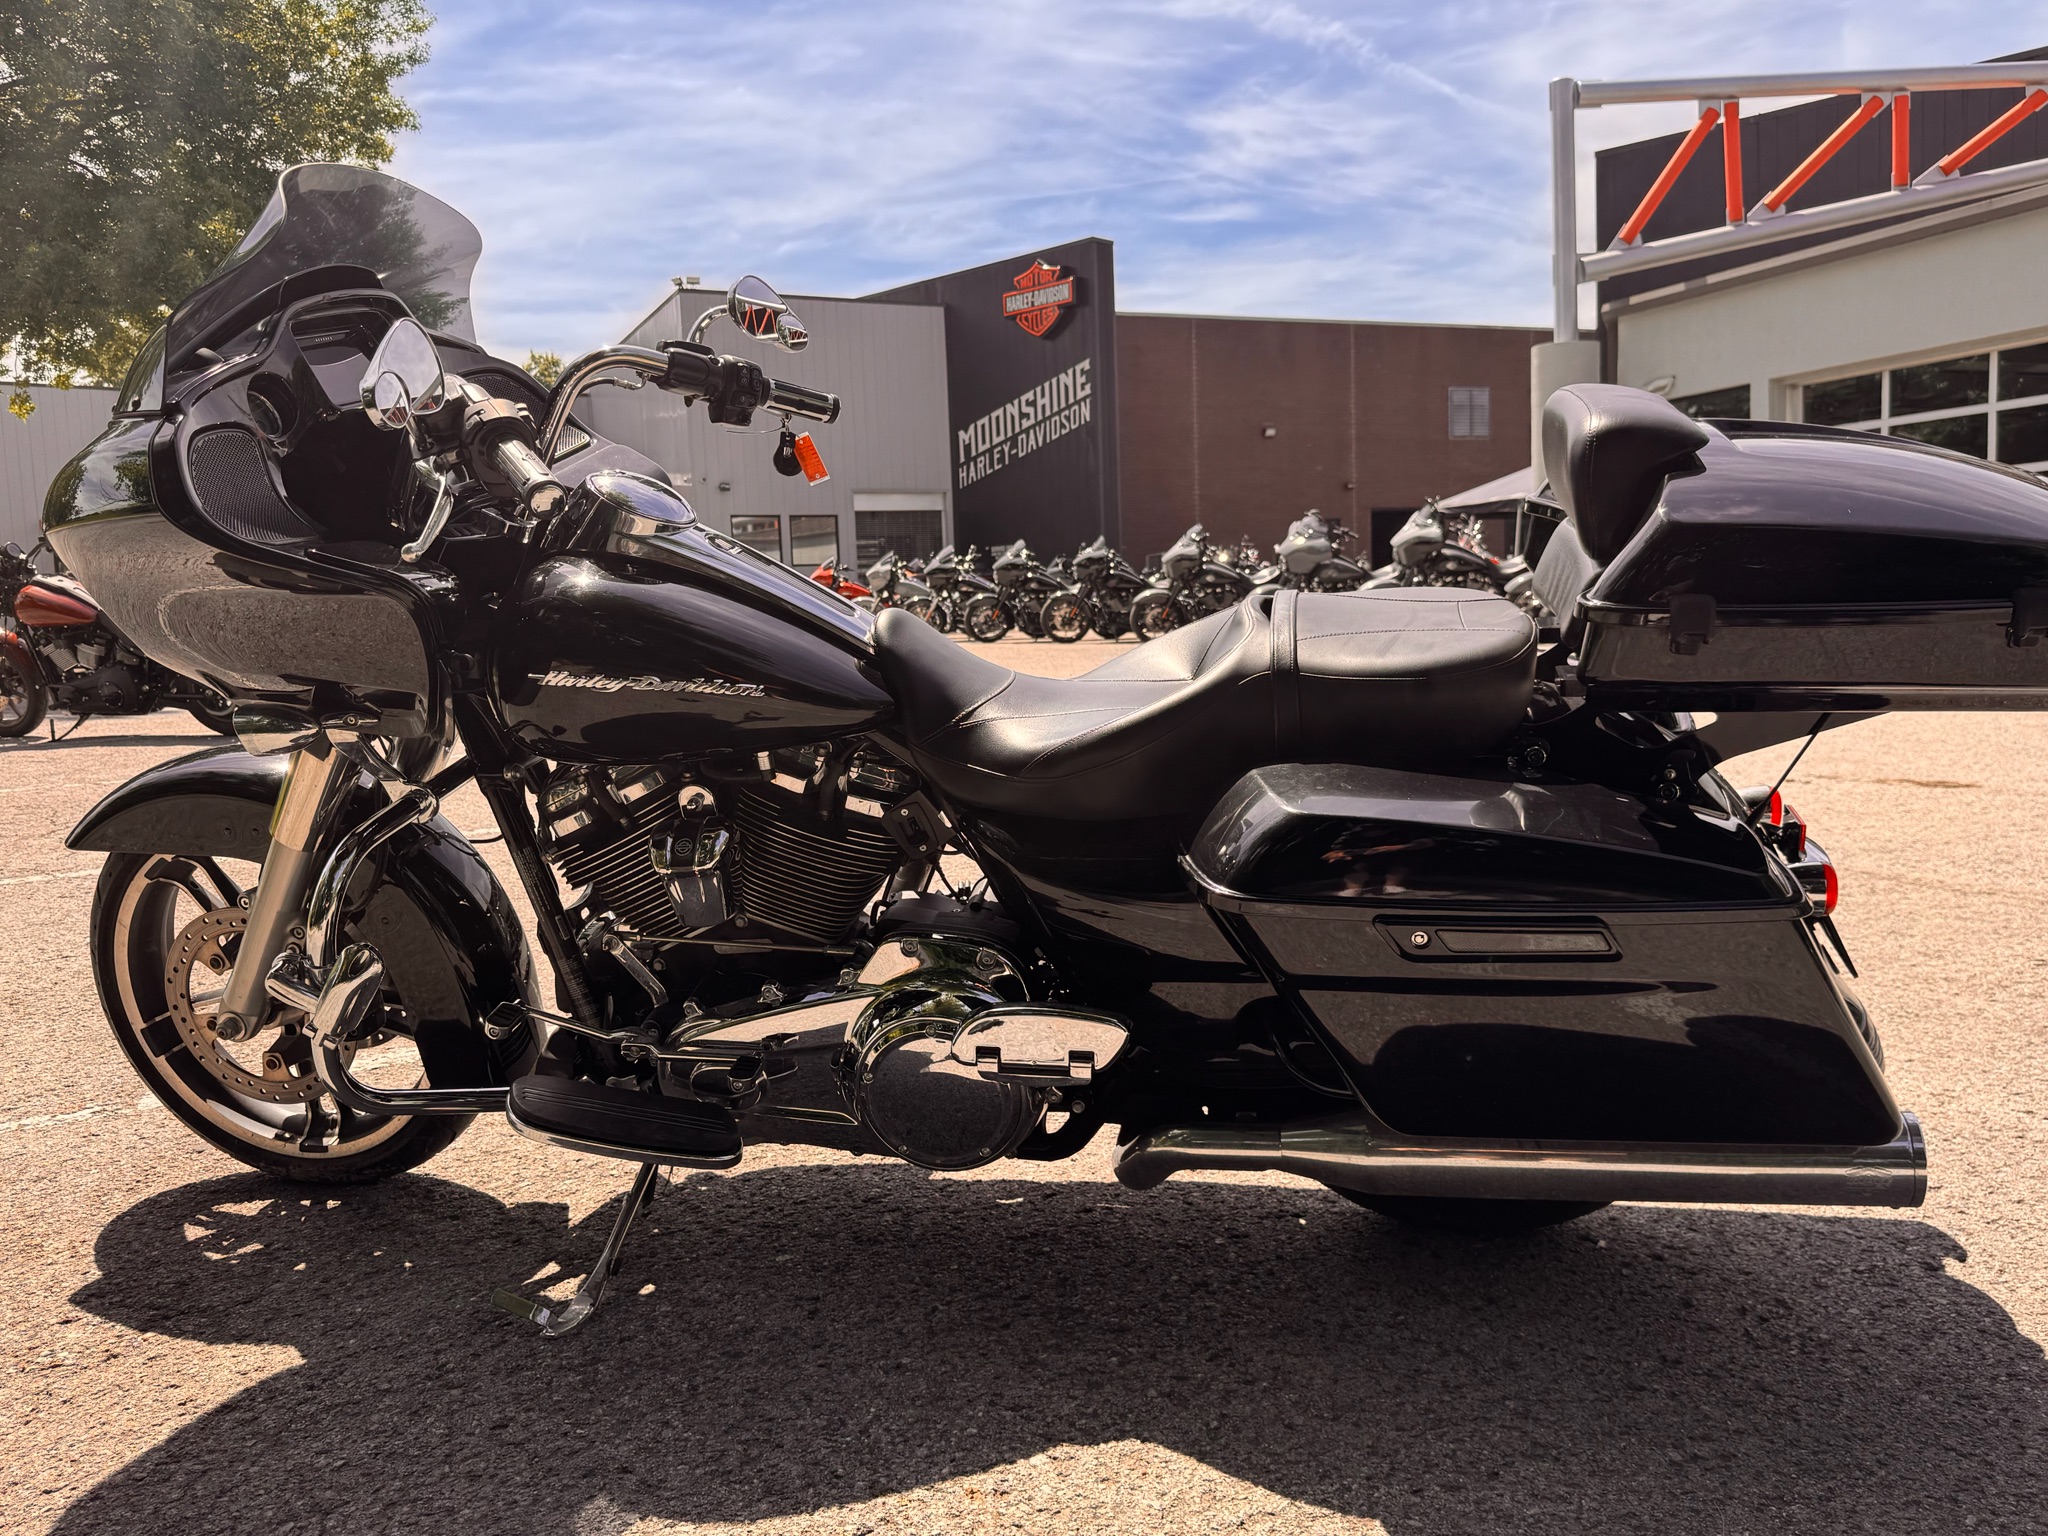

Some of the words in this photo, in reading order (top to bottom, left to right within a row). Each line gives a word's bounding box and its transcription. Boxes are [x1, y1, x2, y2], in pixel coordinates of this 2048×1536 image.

[1020, 268, 1054, 289] MOTOR
[1006, 282, 1070, 313] HARLEY-DAVIDSON
[1021, 306, 1055, 332] CYCLES
[957, 358, 1092, 463] MOONSHINE
[958, 398, 1092, 490] HARLEY-DAVIDSON
[527, 670, 766, 698] Harley-Davidson
